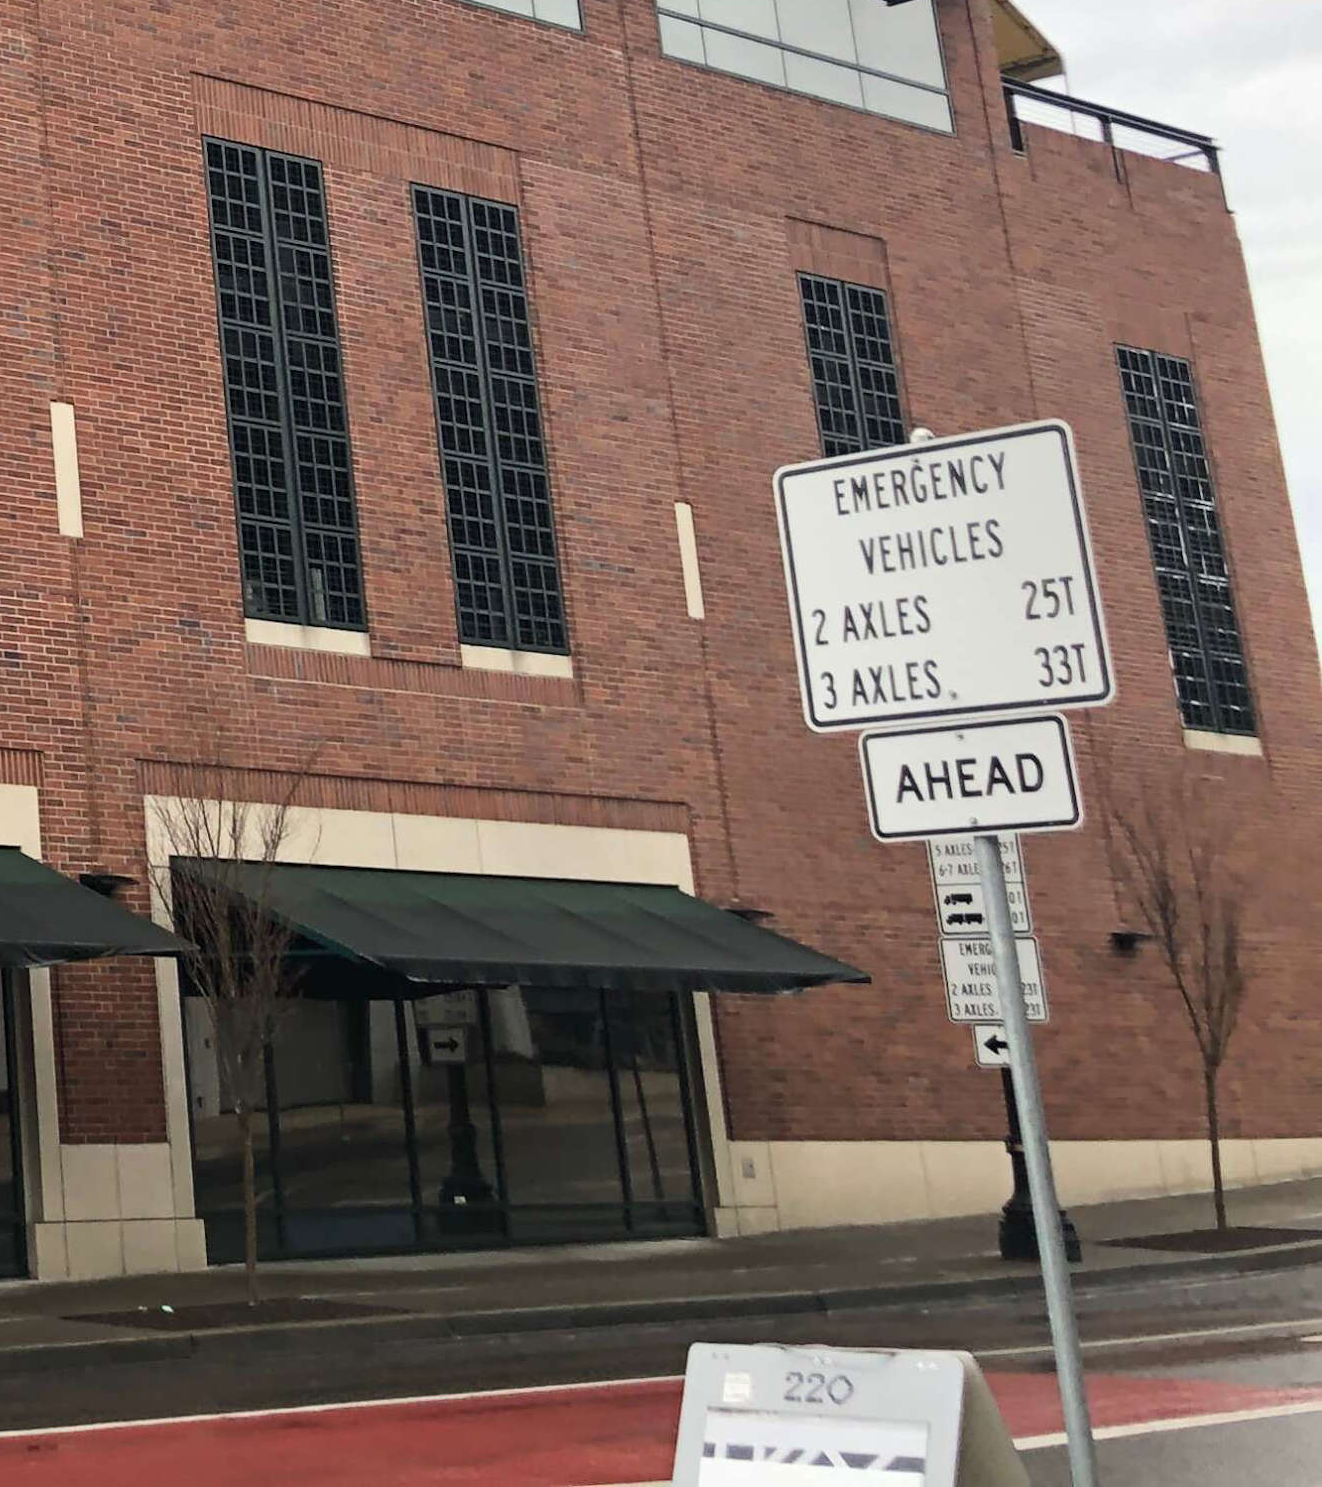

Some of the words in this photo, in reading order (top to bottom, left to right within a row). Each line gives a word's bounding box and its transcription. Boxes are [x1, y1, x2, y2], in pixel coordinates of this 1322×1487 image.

[833, 452, 1006, 515] EMERGENCY
[860, 519, 1004, 575] VEHICLES
[812, 609, 829, 645] 2
[843, 595, 931, 643] AXLES
[1021, 576, 1075, 620] 25T
[821, 672, 837, 709] 3
[852, 660, 942, 706] AXLES
[1034, 644, 1086, 687] 33T
[896, 753, 1044, 803] AHEAD
[945, 843, 972, 856] AXLES
[961, 983, 992, 996] AXLES
[965, 1003, 995, 1016] AXLES
[784, 1371, 854, 1405] 220
